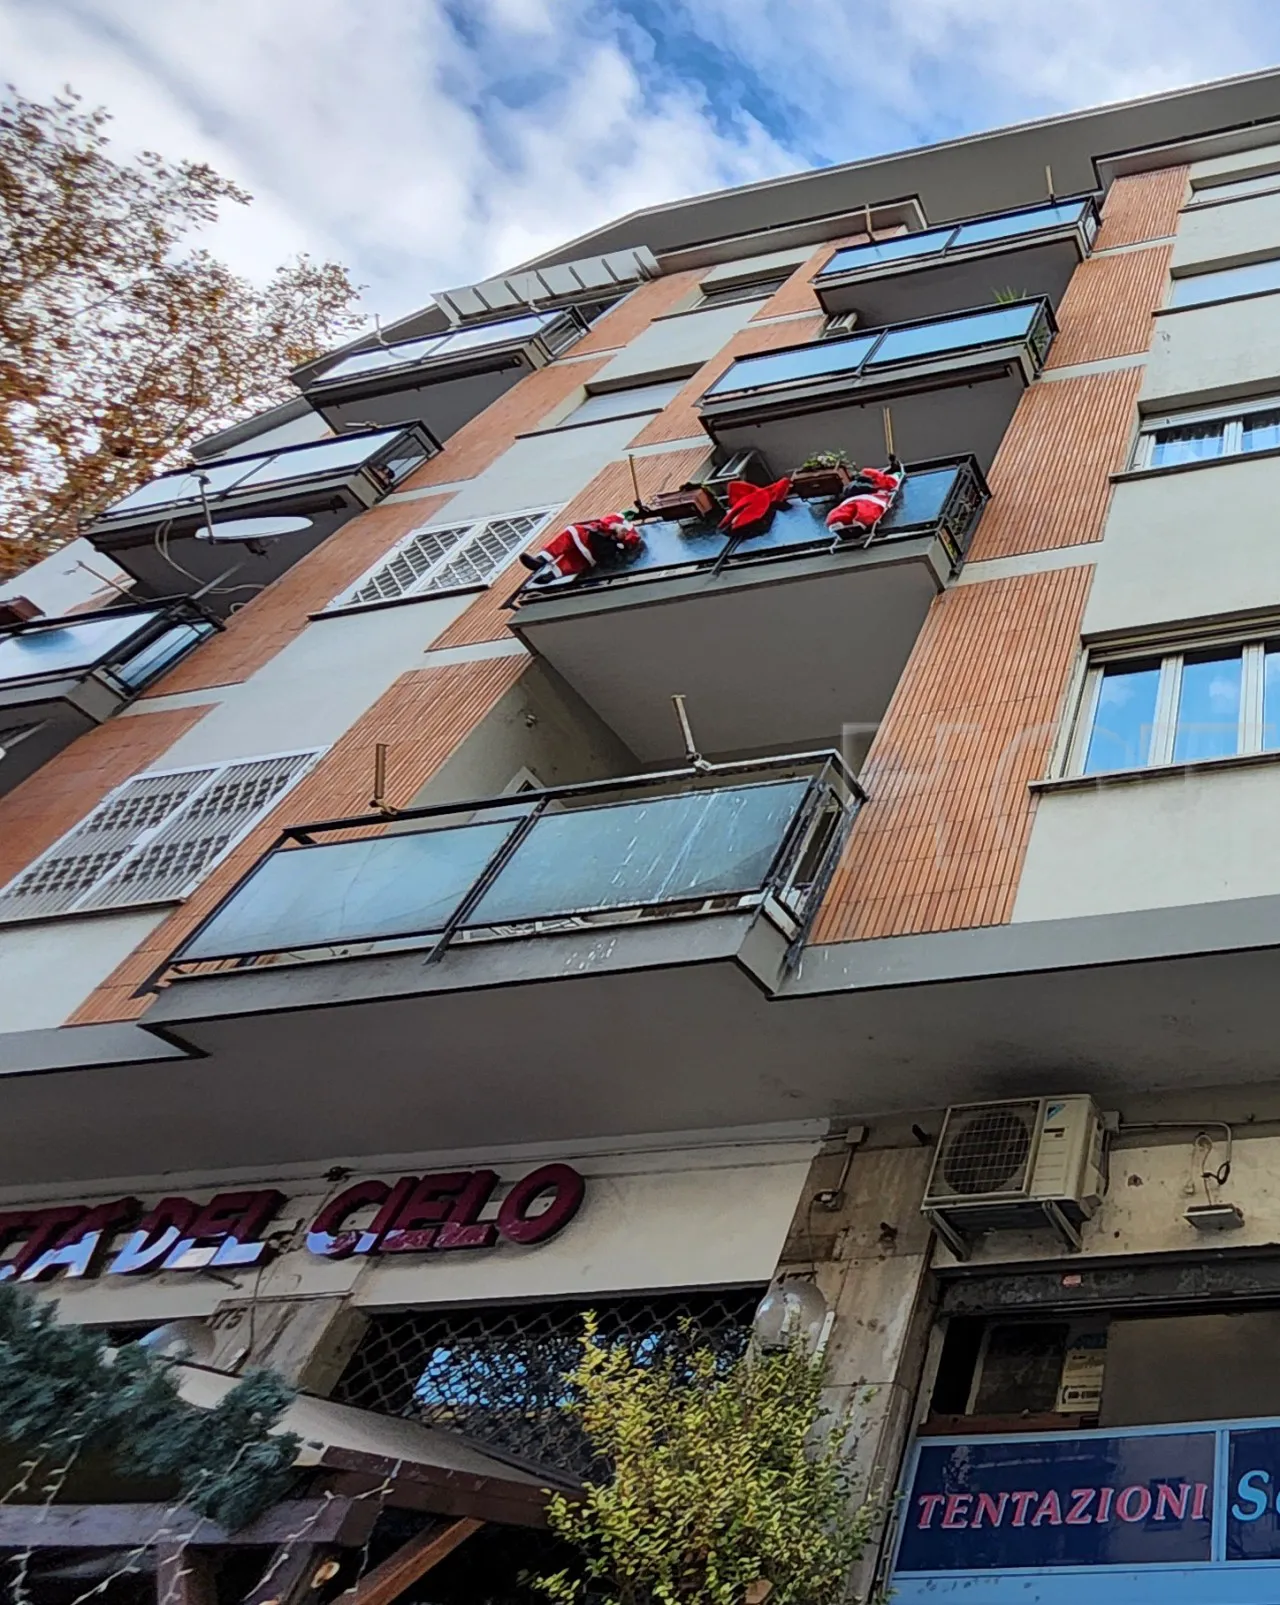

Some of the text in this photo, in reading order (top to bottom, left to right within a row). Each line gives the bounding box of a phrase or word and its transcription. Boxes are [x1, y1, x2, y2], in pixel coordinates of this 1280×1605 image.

[0, 1163, 586, 1283] TA DEL CIELO
[917, 1482, 1208, 1530] TENTAZIONI
